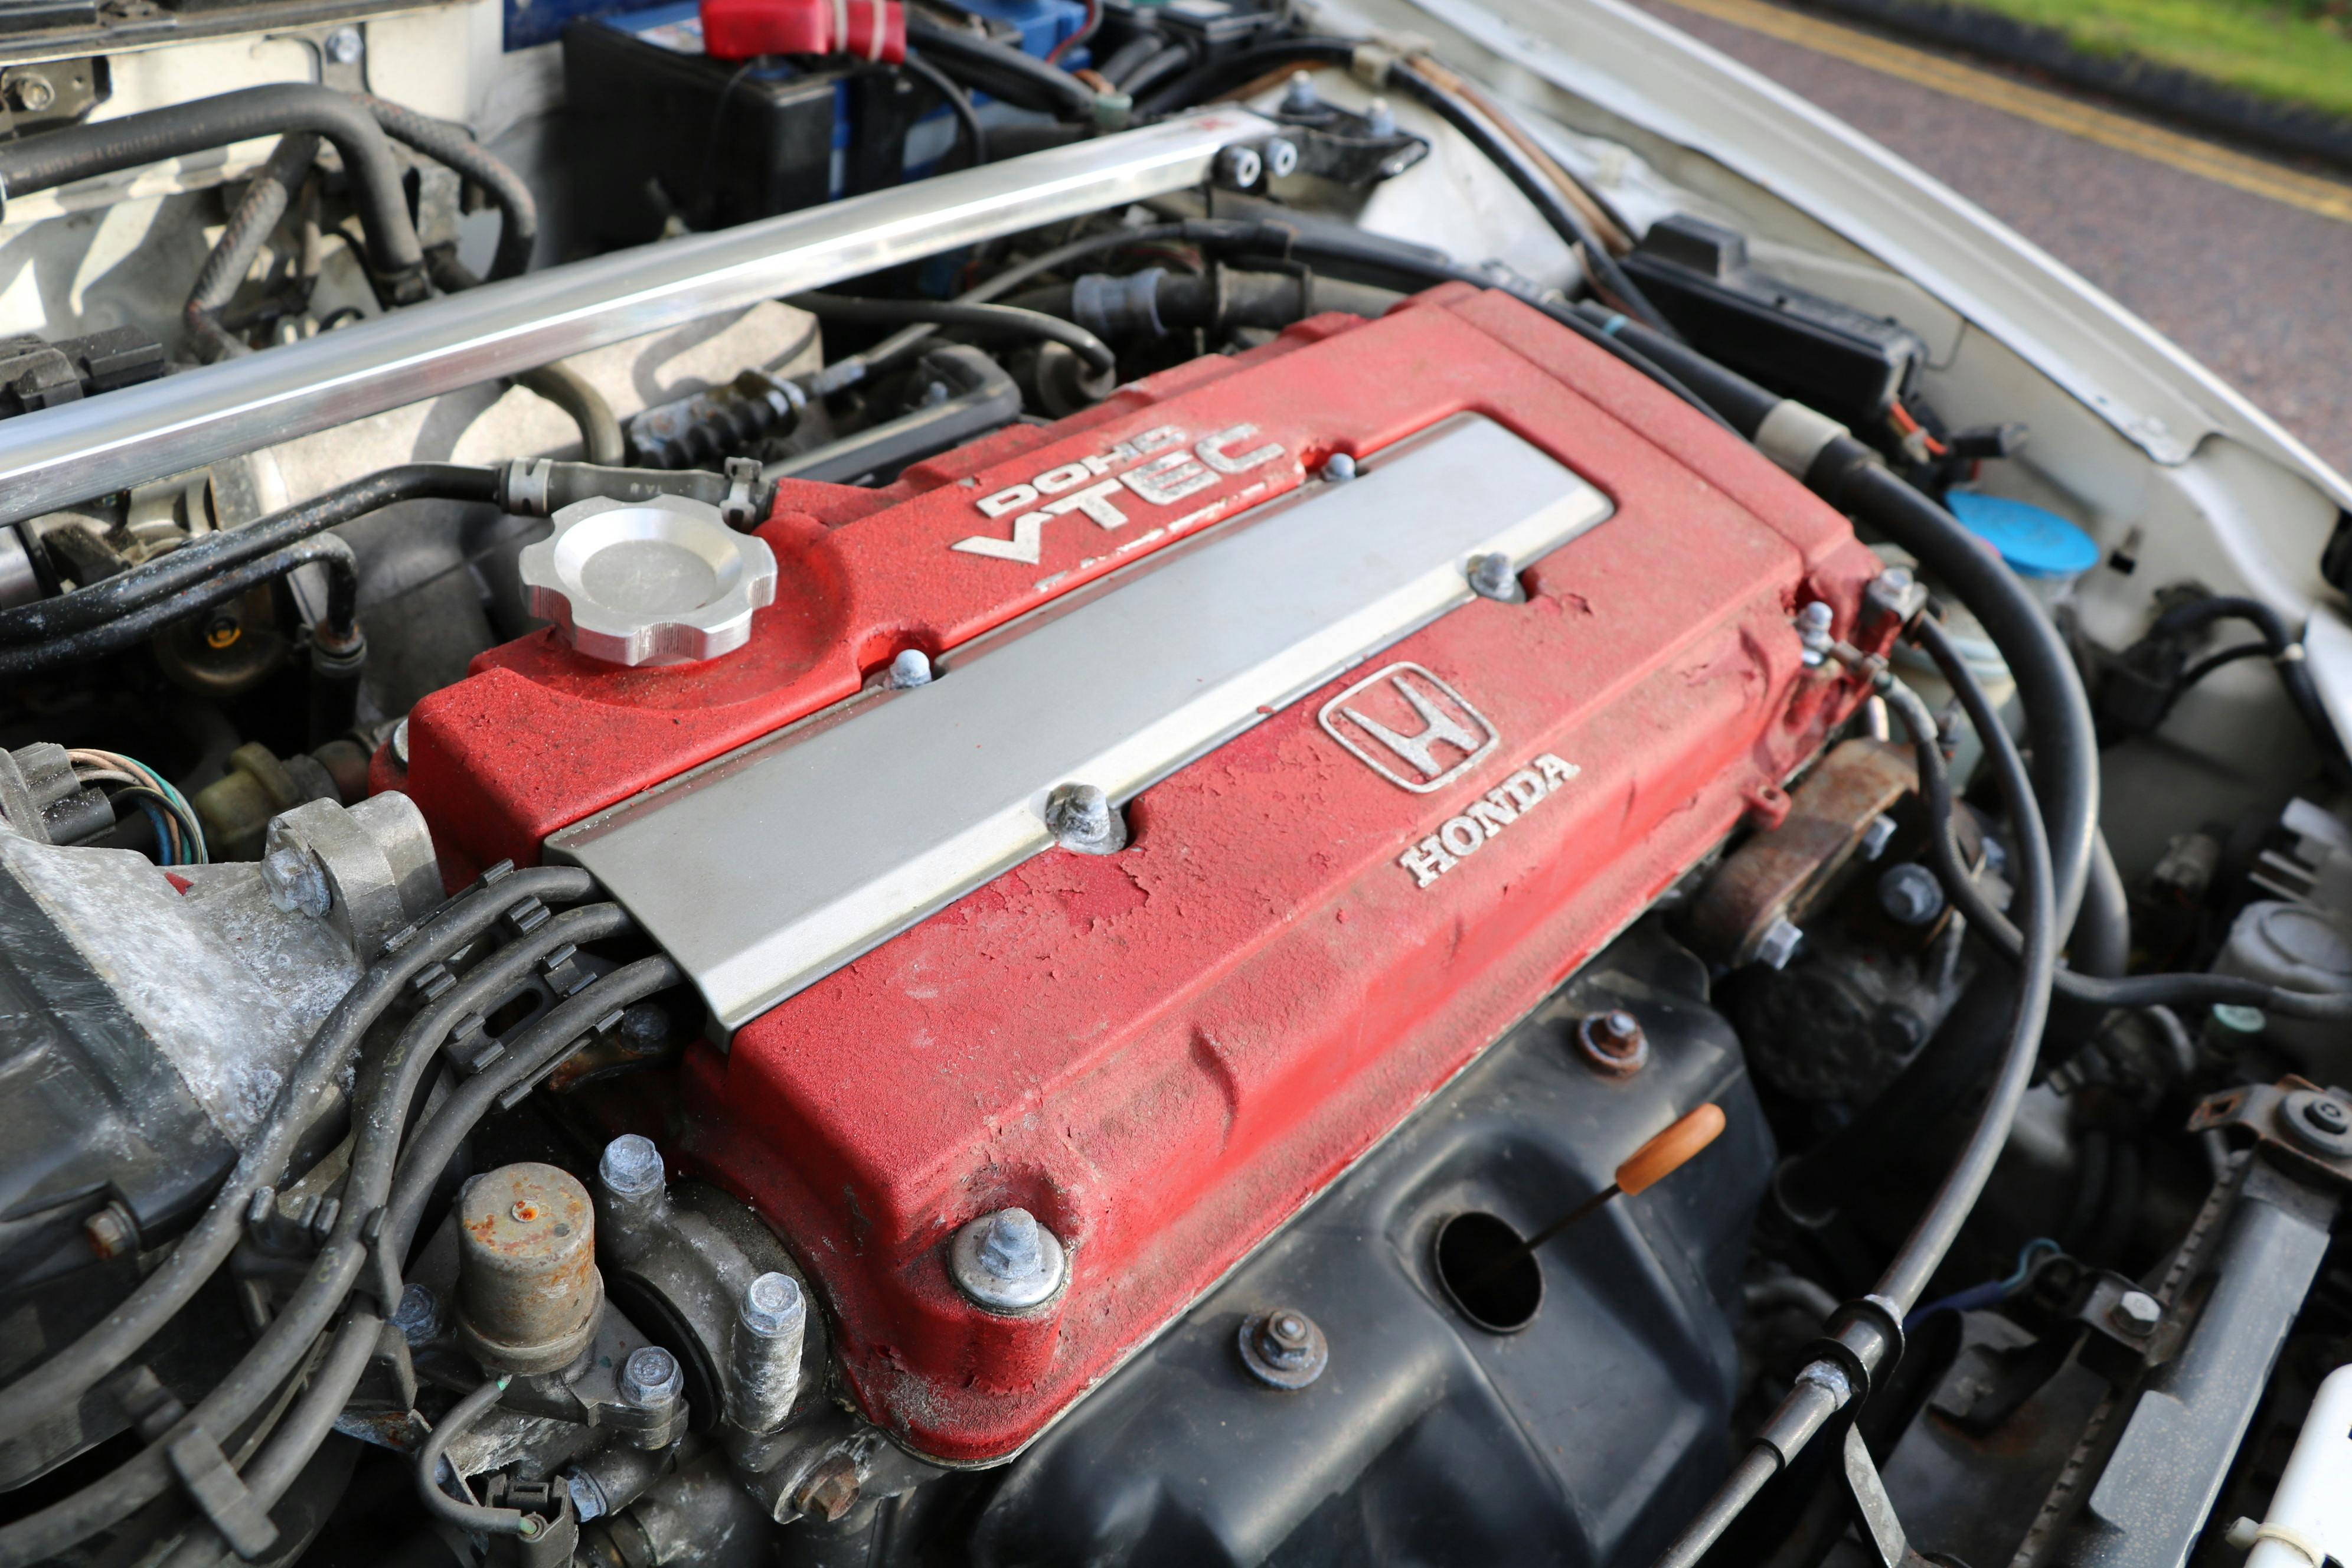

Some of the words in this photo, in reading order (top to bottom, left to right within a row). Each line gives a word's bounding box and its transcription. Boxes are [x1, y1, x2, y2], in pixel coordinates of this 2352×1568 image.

[950, 423, 1286, 565] VTEC
[975, 424, 1187, 519] DOHC
[1399, 753, 1582, 888] HONDA
